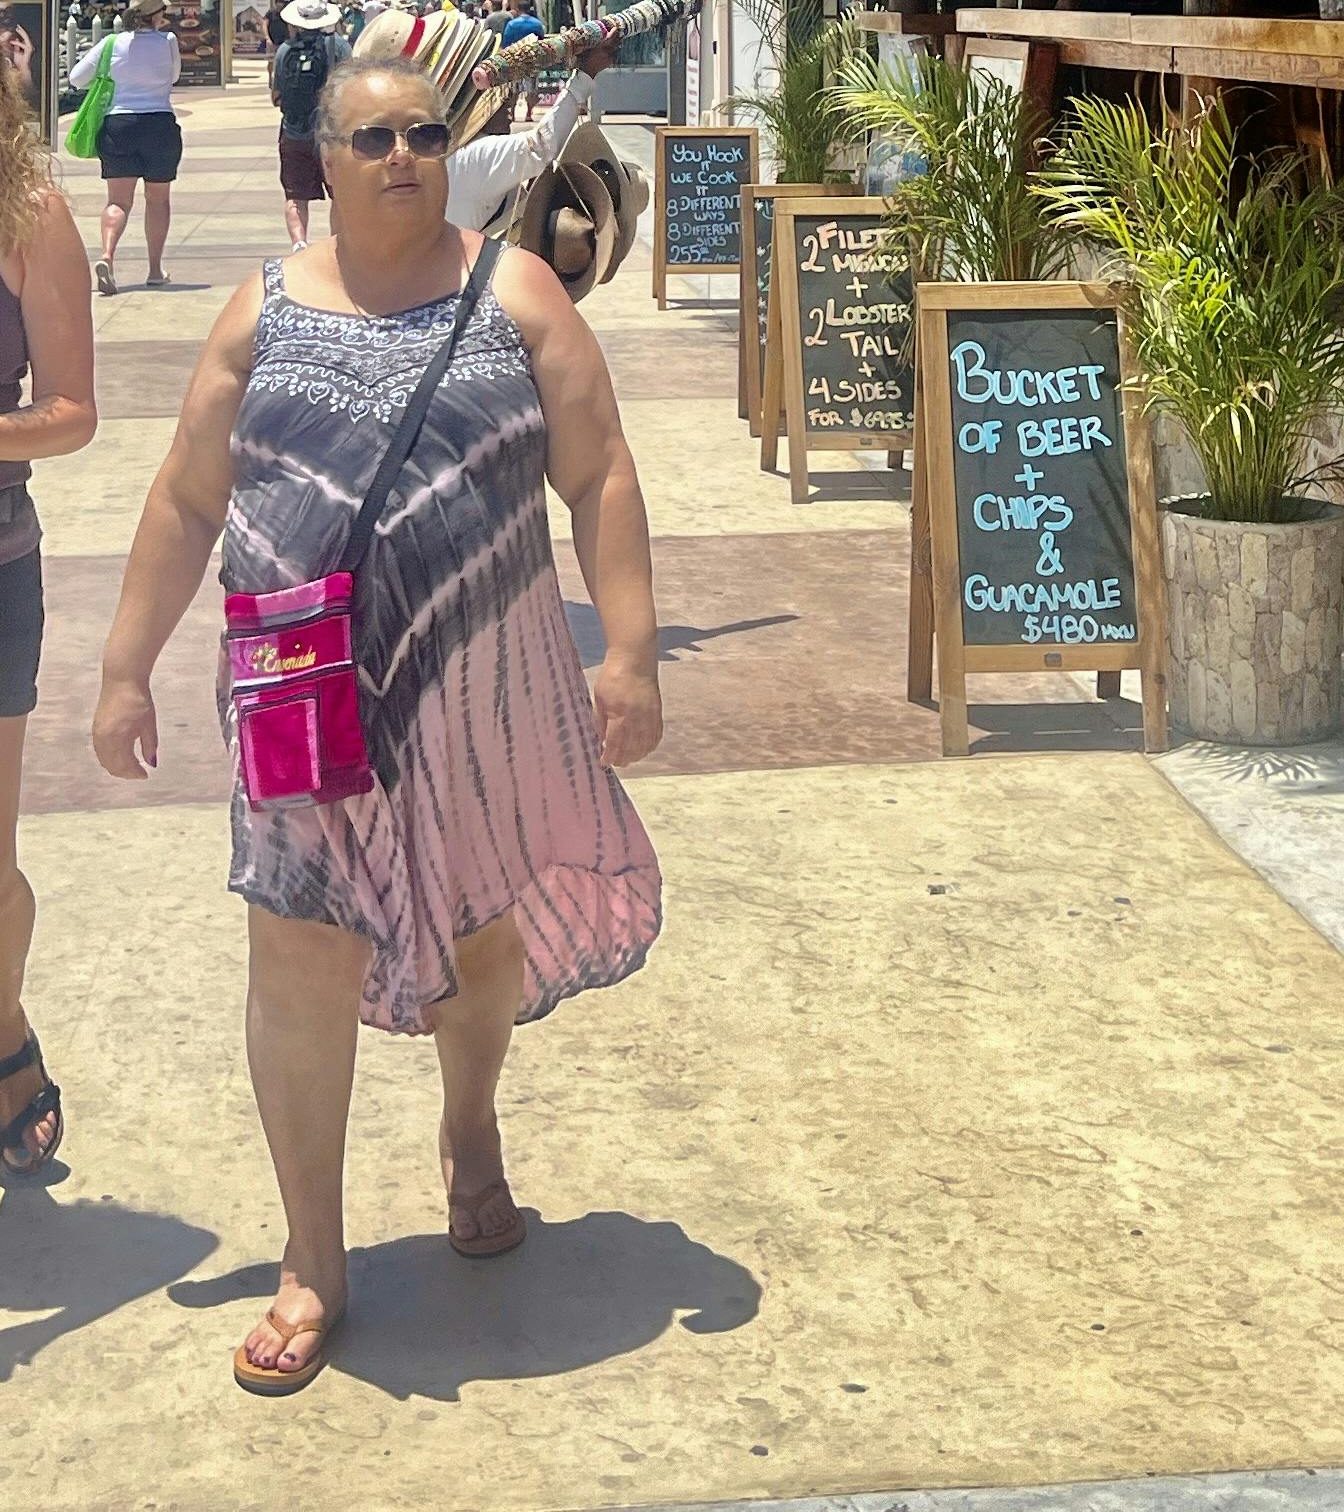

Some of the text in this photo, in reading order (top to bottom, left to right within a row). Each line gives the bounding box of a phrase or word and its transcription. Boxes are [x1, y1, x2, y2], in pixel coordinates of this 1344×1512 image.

[666, 198, 679, 218] 8
[693, 210, 726, 221] WAYS
[667, 222, 681, 241] 8
[800, 234, 826, 272] 2
[845, 276, 869, 299] +
[804, 298, 912, 346] 2 LOBSTER
[839, 330, 900, 358] TAIL
[858, 361, 877, 378] +
[808, 377, 902, 405] 4 SIDES
[807, 408, 844, 427] FOR
[958, 420, 1003, 455] OF
[1019, 415, 1113, 458] BEER
[1014, 463, 1045, 492] +
[972, 493, 1075, 532] CHIPS
[1035, 531, 1065, 577] &
[964, 573, 1123, 614] GUACAMOLE
[1021, 614, 1099, 644] $480
